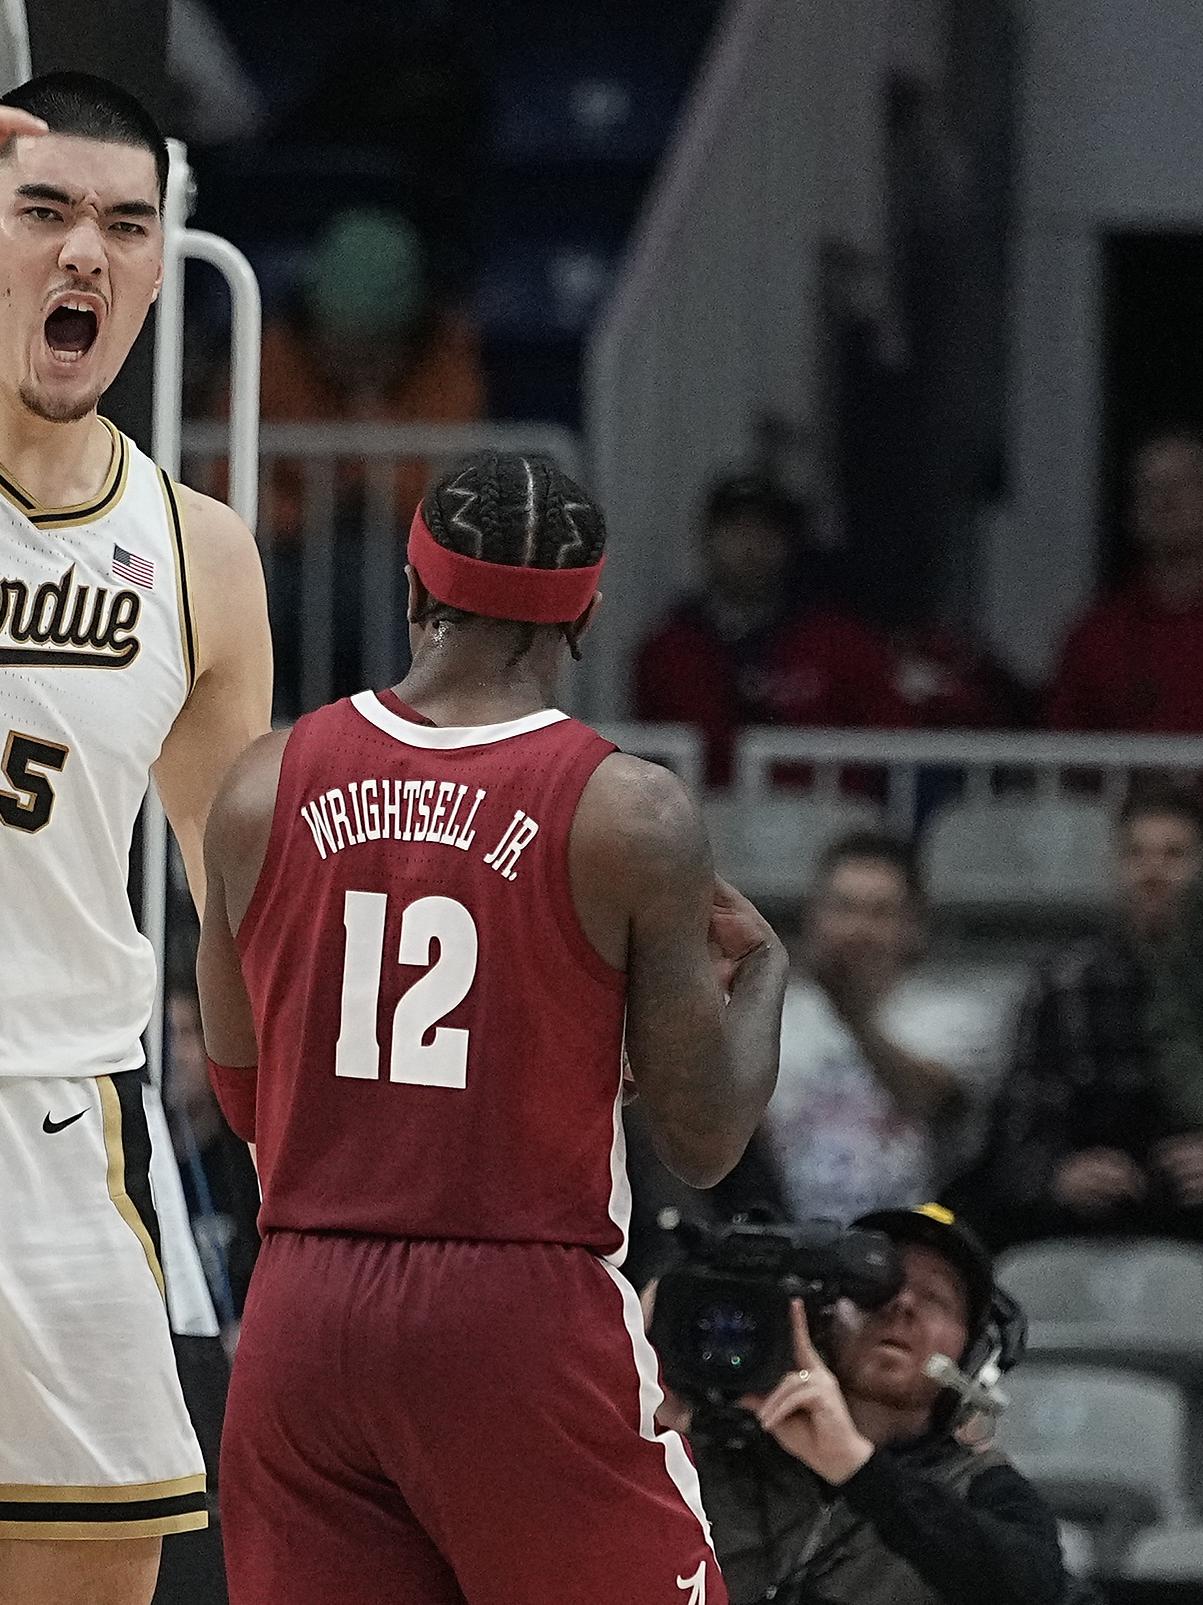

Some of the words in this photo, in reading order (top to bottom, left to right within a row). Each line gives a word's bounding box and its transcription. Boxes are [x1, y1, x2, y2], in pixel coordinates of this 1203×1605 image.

[300, 779, 487, 860] WRIGHTSELL
[482, 809, 540, 881] JR.
[335, 890, 479, 1089] 12
